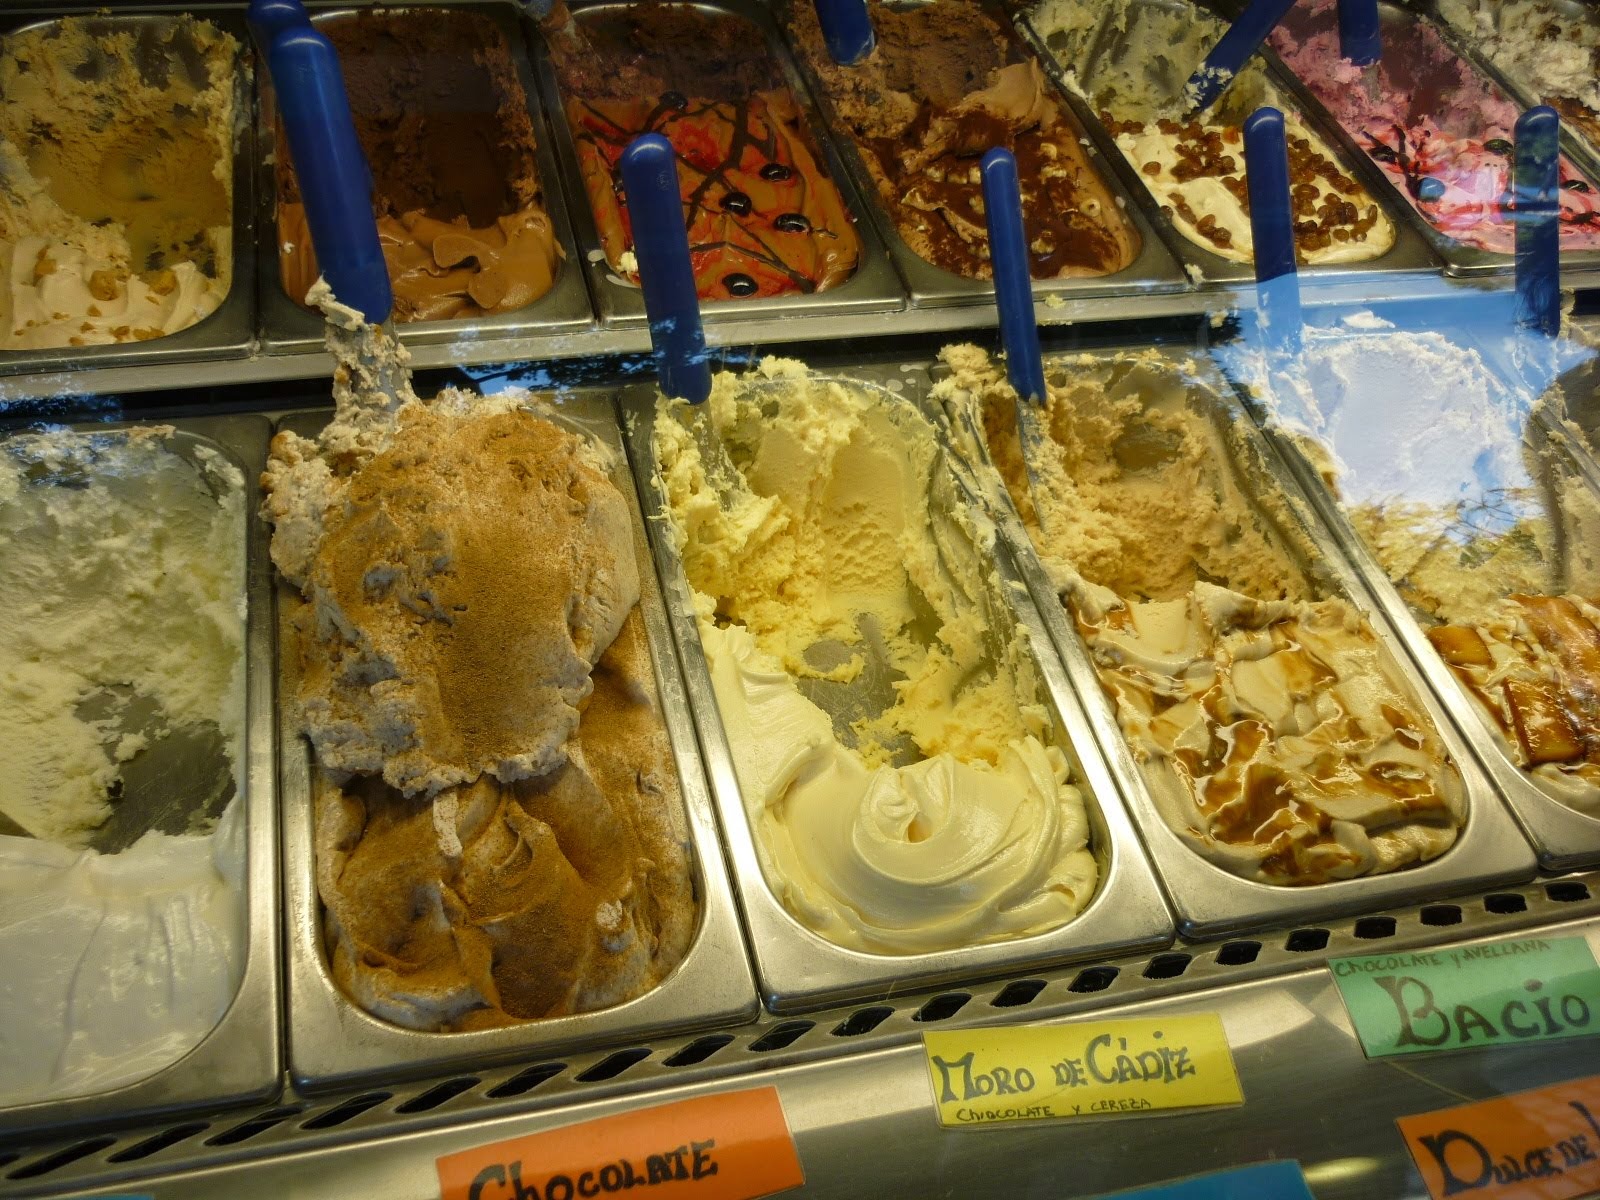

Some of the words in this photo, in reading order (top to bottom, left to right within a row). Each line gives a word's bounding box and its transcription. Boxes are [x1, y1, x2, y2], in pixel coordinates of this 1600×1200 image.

[1461, 941, 1551, 961] AVELLANA
[931, 1051, 1036, 1104] MORO
[1051, 1057, 1088, 1088] DE
[1090, 1097, 1151, 1112] CEREZA
[1555, 1133, 1597, 1168] DE
